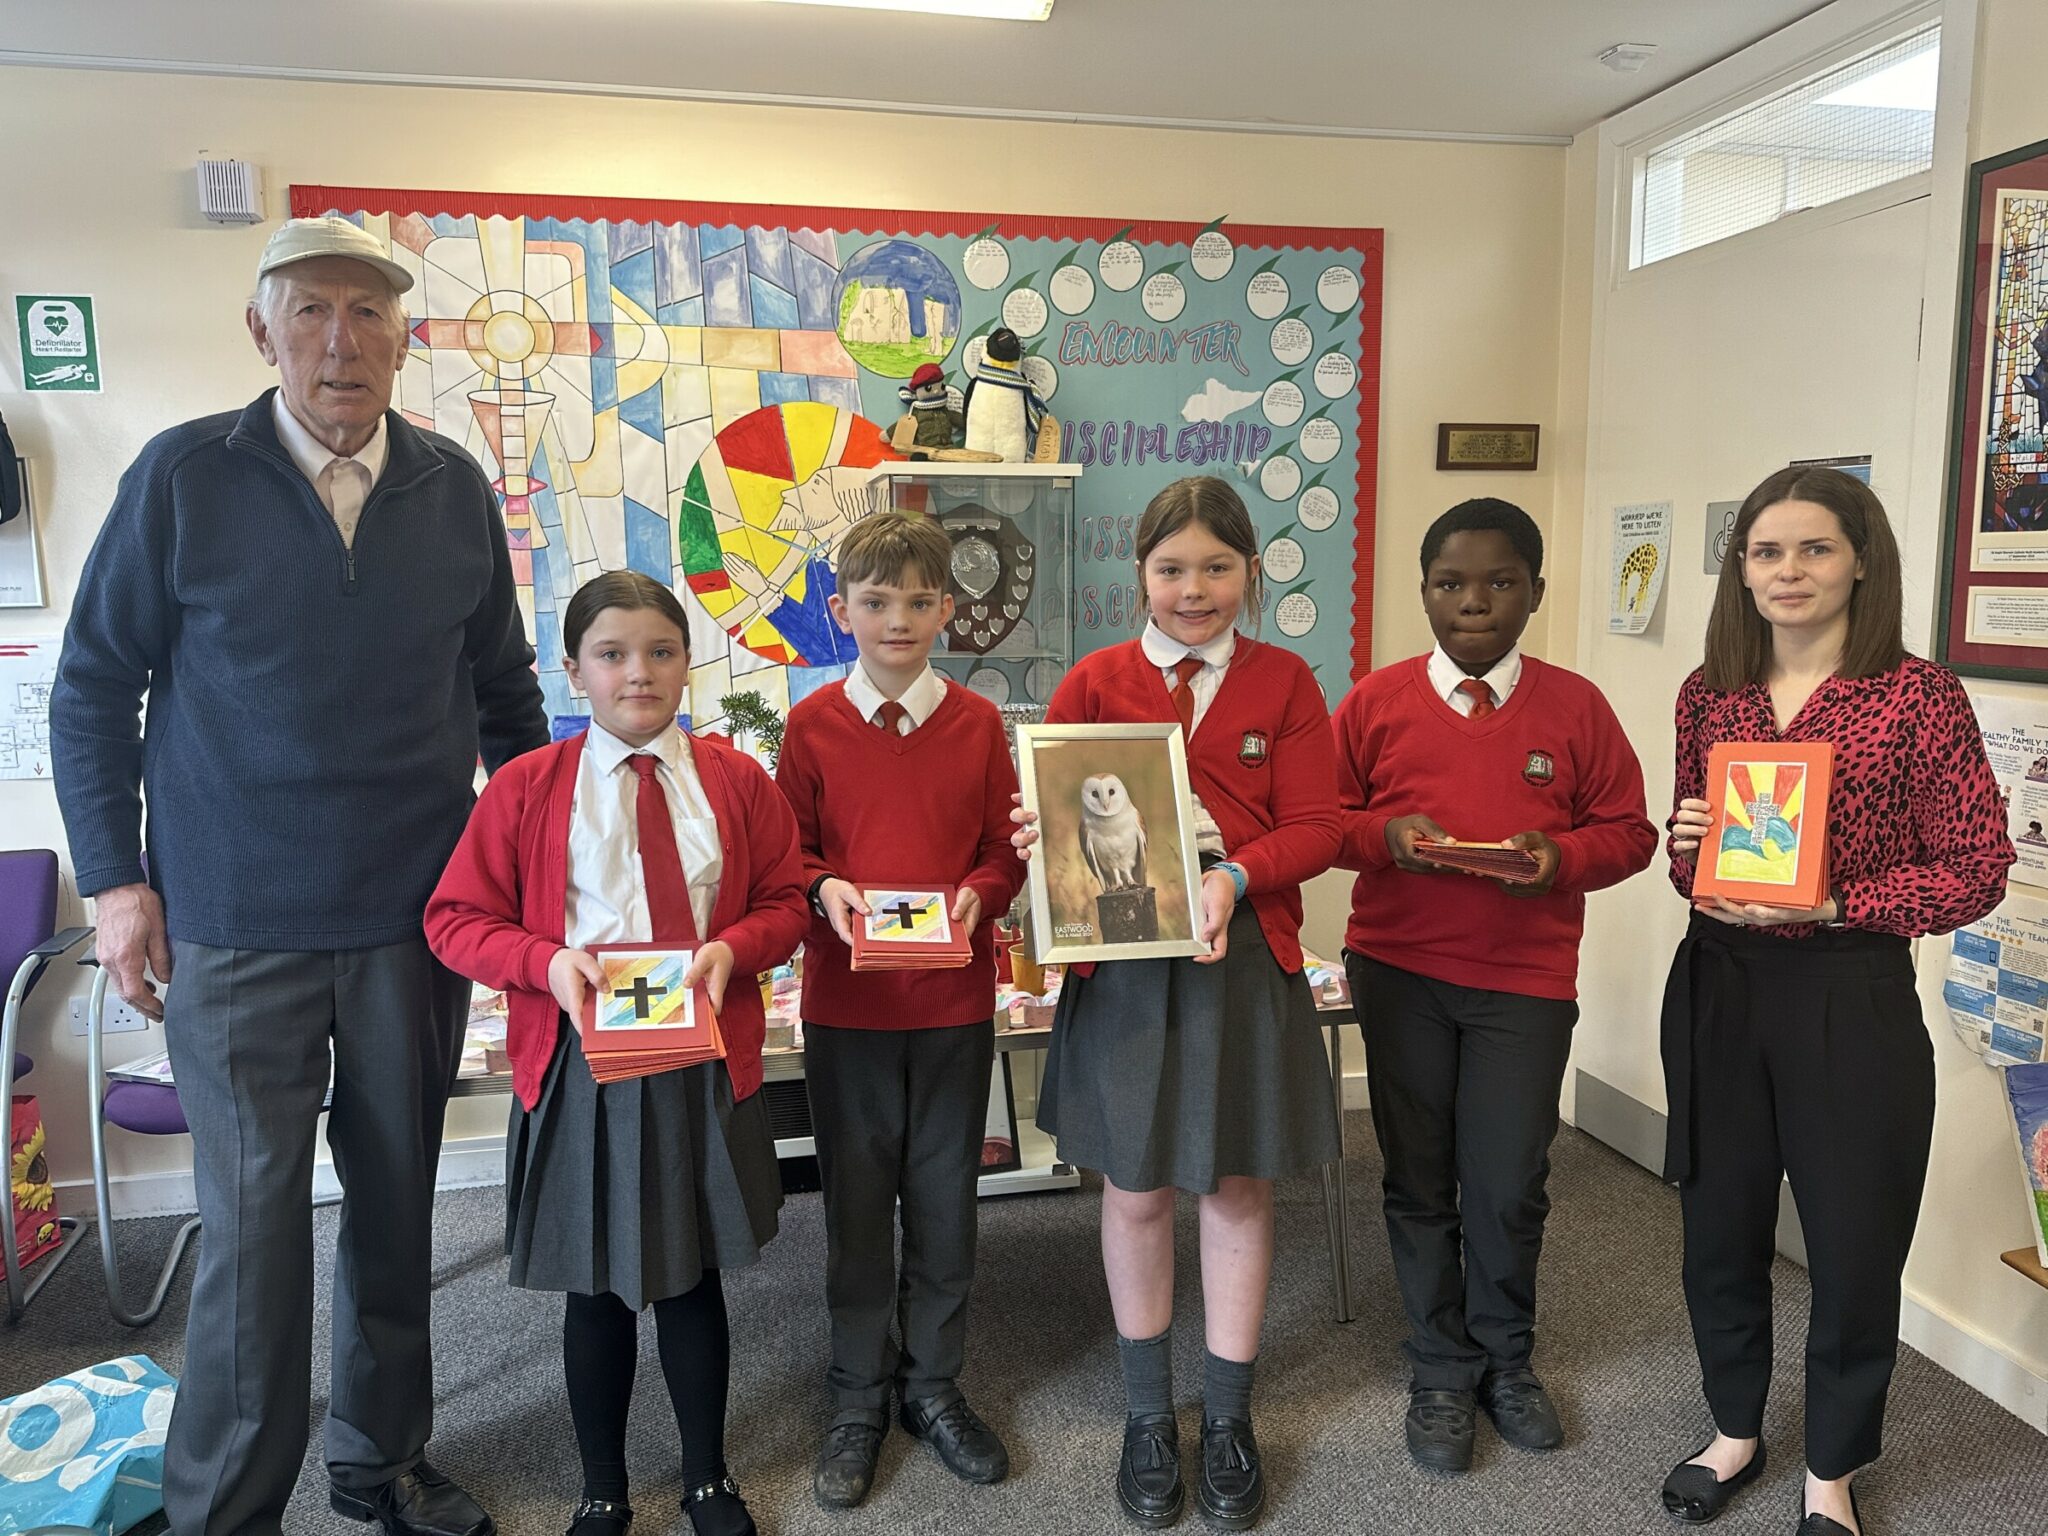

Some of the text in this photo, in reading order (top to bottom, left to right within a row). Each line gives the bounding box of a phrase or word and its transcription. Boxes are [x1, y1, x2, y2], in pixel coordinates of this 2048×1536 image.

[35, 339, 82, 347] Defibrillator
[1059, 320, 1249, 376] ENCOUNTER
[1062, 420, 1271, 467] ISCIPLESHIP
[2011, 727, 2025, 736] THE
[2012, 736, 2042, 747] FAMILY
[2009, 743, 2020, 752] DO
[2022, 745, 2034, 754] WE
[1996, 916, 2011, 926] THE
[1055, 923, 1093, 933] EASTWOOD
[1996, 924, 2025, 938] FAMILY
